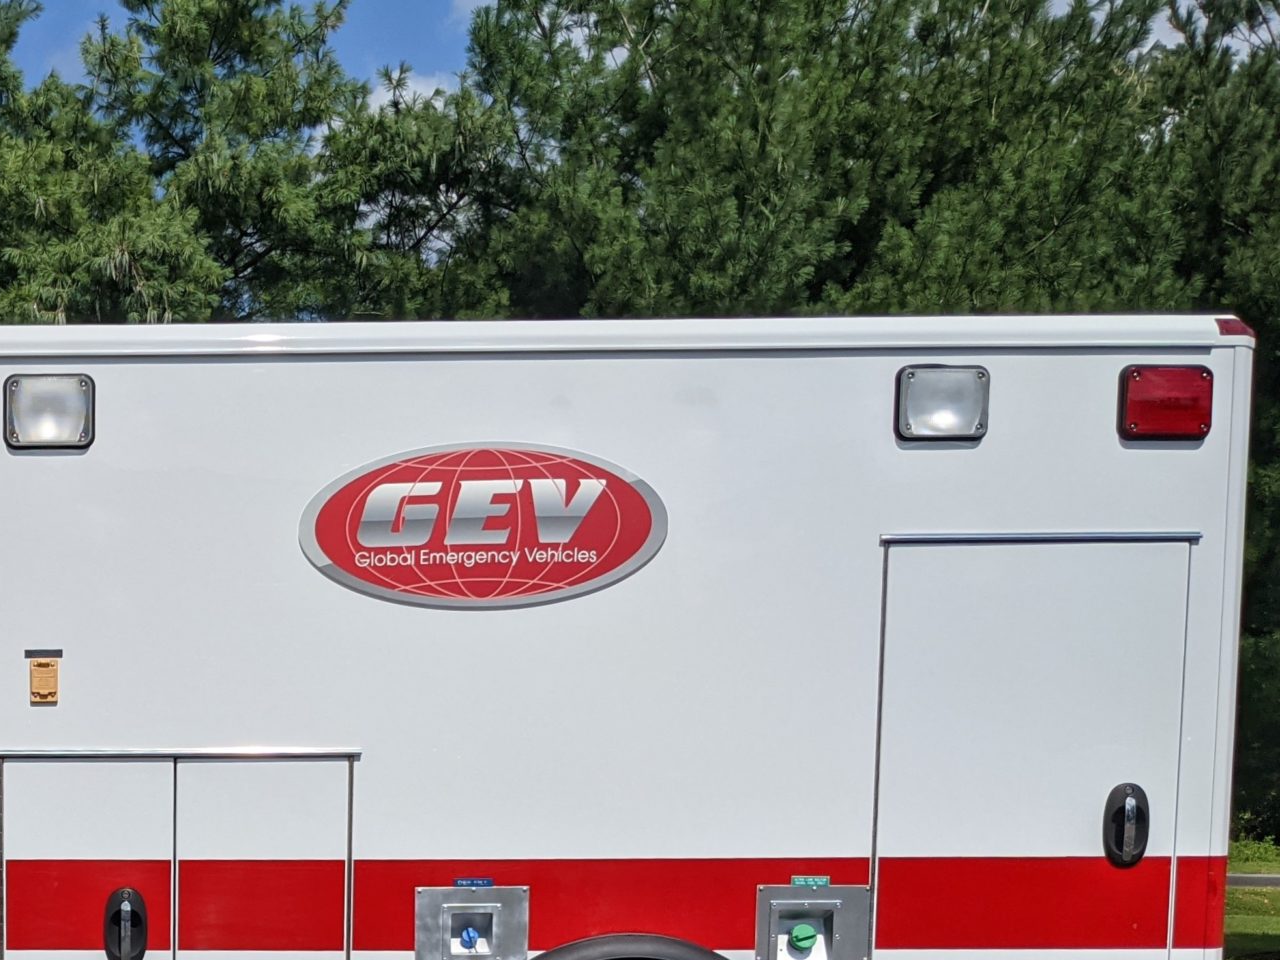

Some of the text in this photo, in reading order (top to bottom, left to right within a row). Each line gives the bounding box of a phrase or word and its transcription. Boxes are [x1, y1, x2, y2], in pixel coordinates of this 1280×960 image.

[356, 478, 607, 548] GEV
[355, 547, 597, 567] Global Emergency Vehicles
